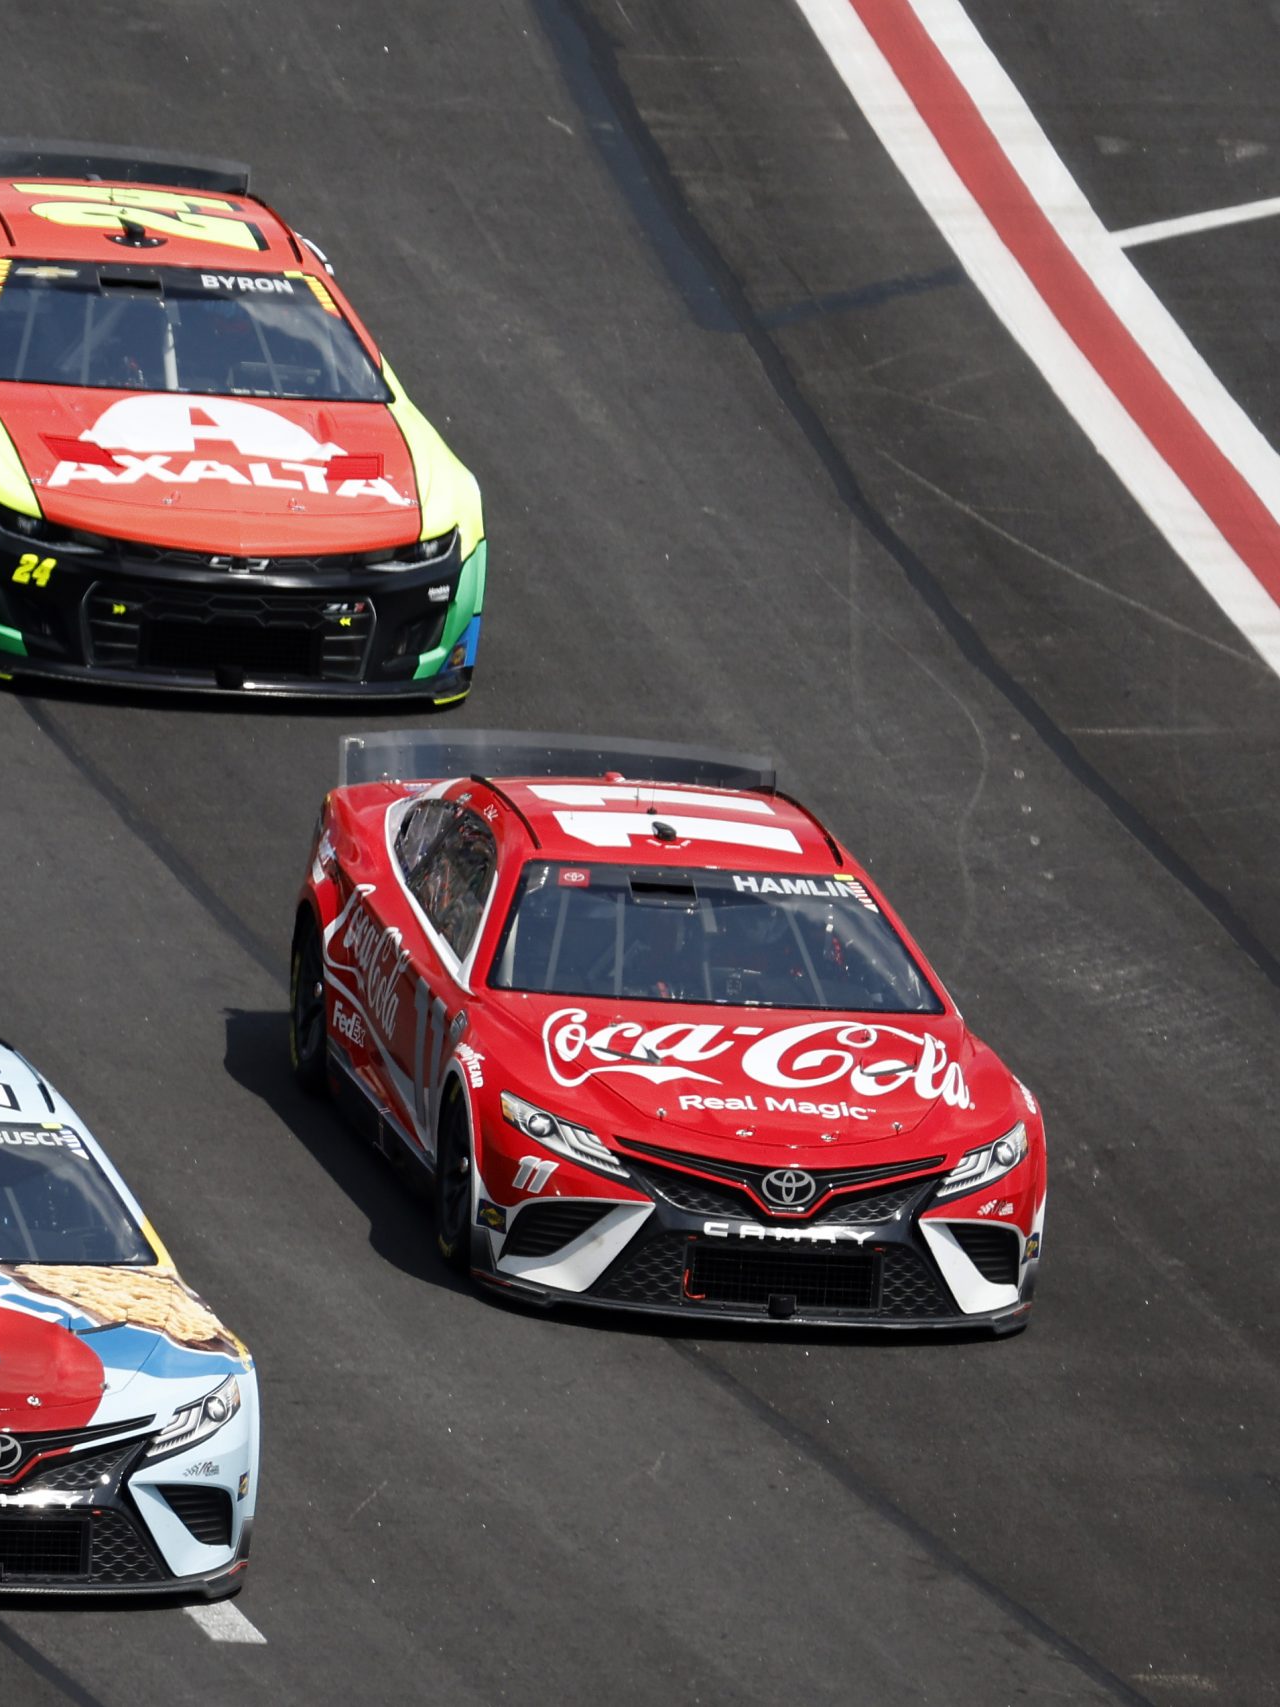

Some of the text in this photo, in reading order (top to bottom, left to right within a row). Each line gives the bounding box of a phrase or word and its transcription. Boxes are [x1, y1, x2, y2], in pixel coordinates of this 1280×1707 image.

[11, 182, 269, 252] 24
[201, 274, 294, 295] BYRON
[47, 454, 411, 507] AXALTA
[12, 553, 57, 587] 24
[526, 784, 804, 855] 11
[732, 875, 858, 899] HAMLIN
[332, 1000, 367, 1048] FedEx
[542, 1007, 970, 1112] Coca-Cola
[678, 1094, 757, 1111] Real
[511, 1155, 560, 1194] 11
